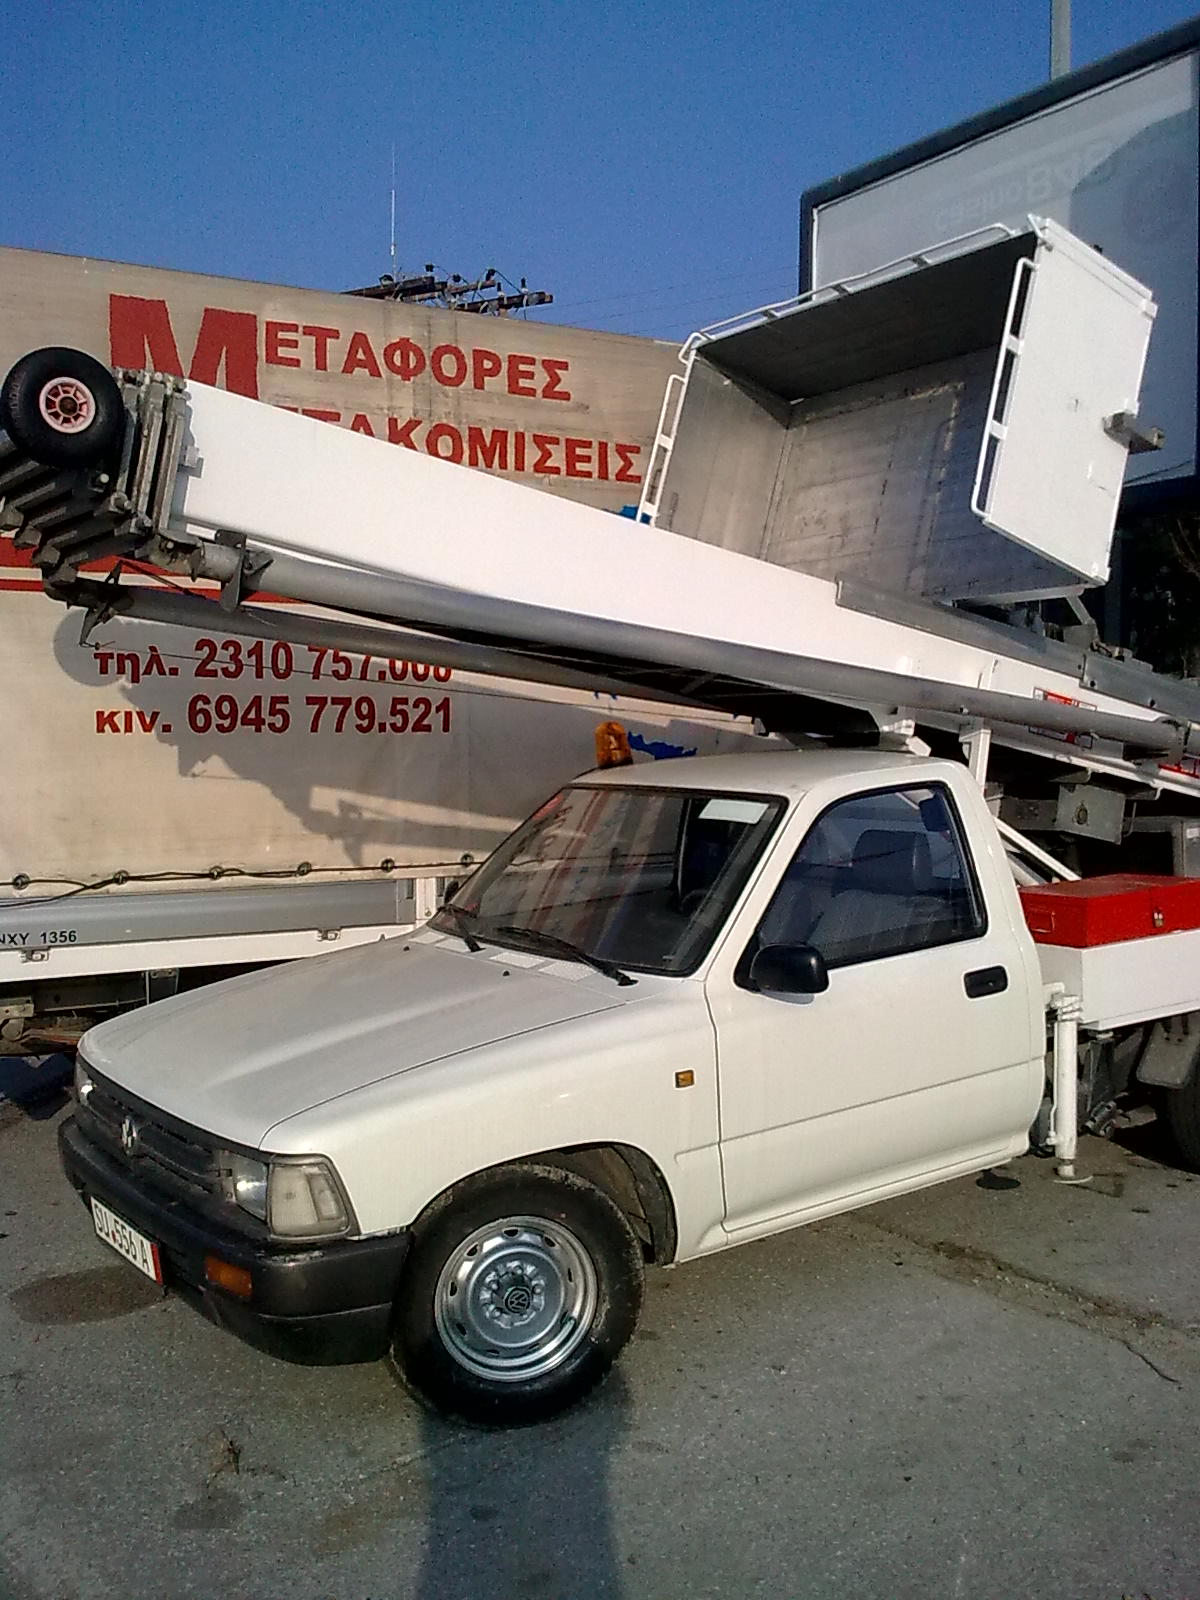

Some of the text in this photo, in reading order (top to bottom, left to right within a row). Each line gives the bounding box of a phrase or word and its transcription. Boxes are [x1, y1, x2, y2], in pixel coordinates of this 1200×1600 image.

[194, 639, 293, 680] 2310
[188, 695, 290, 733] 6945
[306, 696, 451, 733] 779.521
[40, 930, 77, 944] 1356
